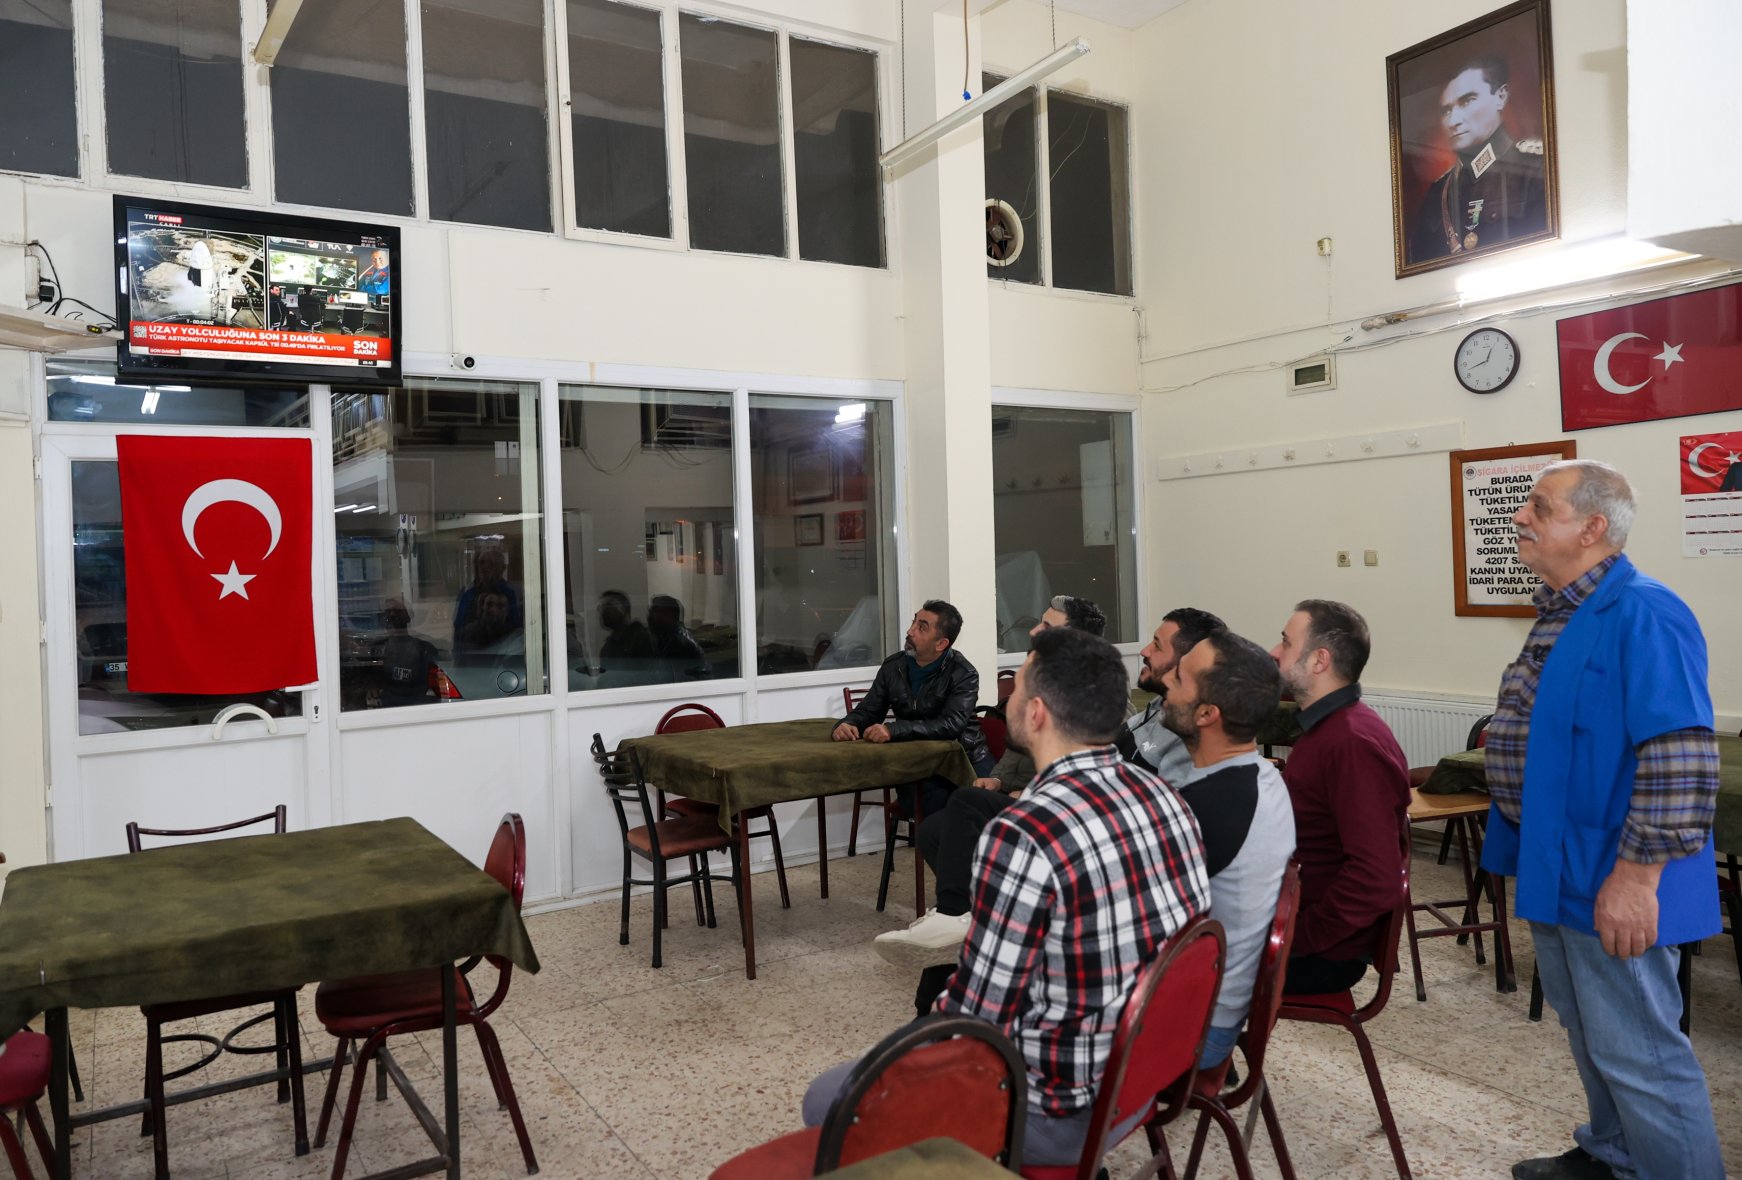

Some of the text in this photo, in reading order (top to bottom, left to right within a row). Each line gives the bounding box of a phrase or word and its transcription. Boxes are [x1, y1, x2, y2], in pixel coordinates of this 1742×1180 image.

[149, 325, 178, 334] UZAY
[181, 326, 257, 339] YOLCULUĞUNA
[258, 332, 280, 340] SON
[289, 334, 326, 344] DAKİKA
[168, 335, 208, 343] ASTRONOTU
[306, 343, 346, 351] FIRLATILIYOR
[353, 340, 378, 350] SON
[1477, 467, 1508, 476] SİGARA
[1490, 475, 1533, 485] BURADA
[1468, 484, 1535, 497] TÜTÜN ÜRÜN
[1479, 495, 1529, 505] TÜKETİLM
[1487, 506, 1523, 515] YASAK
[1474, 525, 1518, 535] TÜKETİL
[1483, 536, 1504, 545] GÖZ
[1476, 547, 1518, 555] SORUML
[1485, 557, 1508, 565] 4207
[1470, 567, 1505, 575] KANUN
[1469, 576, 1494, 585] İDARİ
[1497, 577, 1524, 585] PARA
[1487, 587, 1536, 595] UYGULAN
